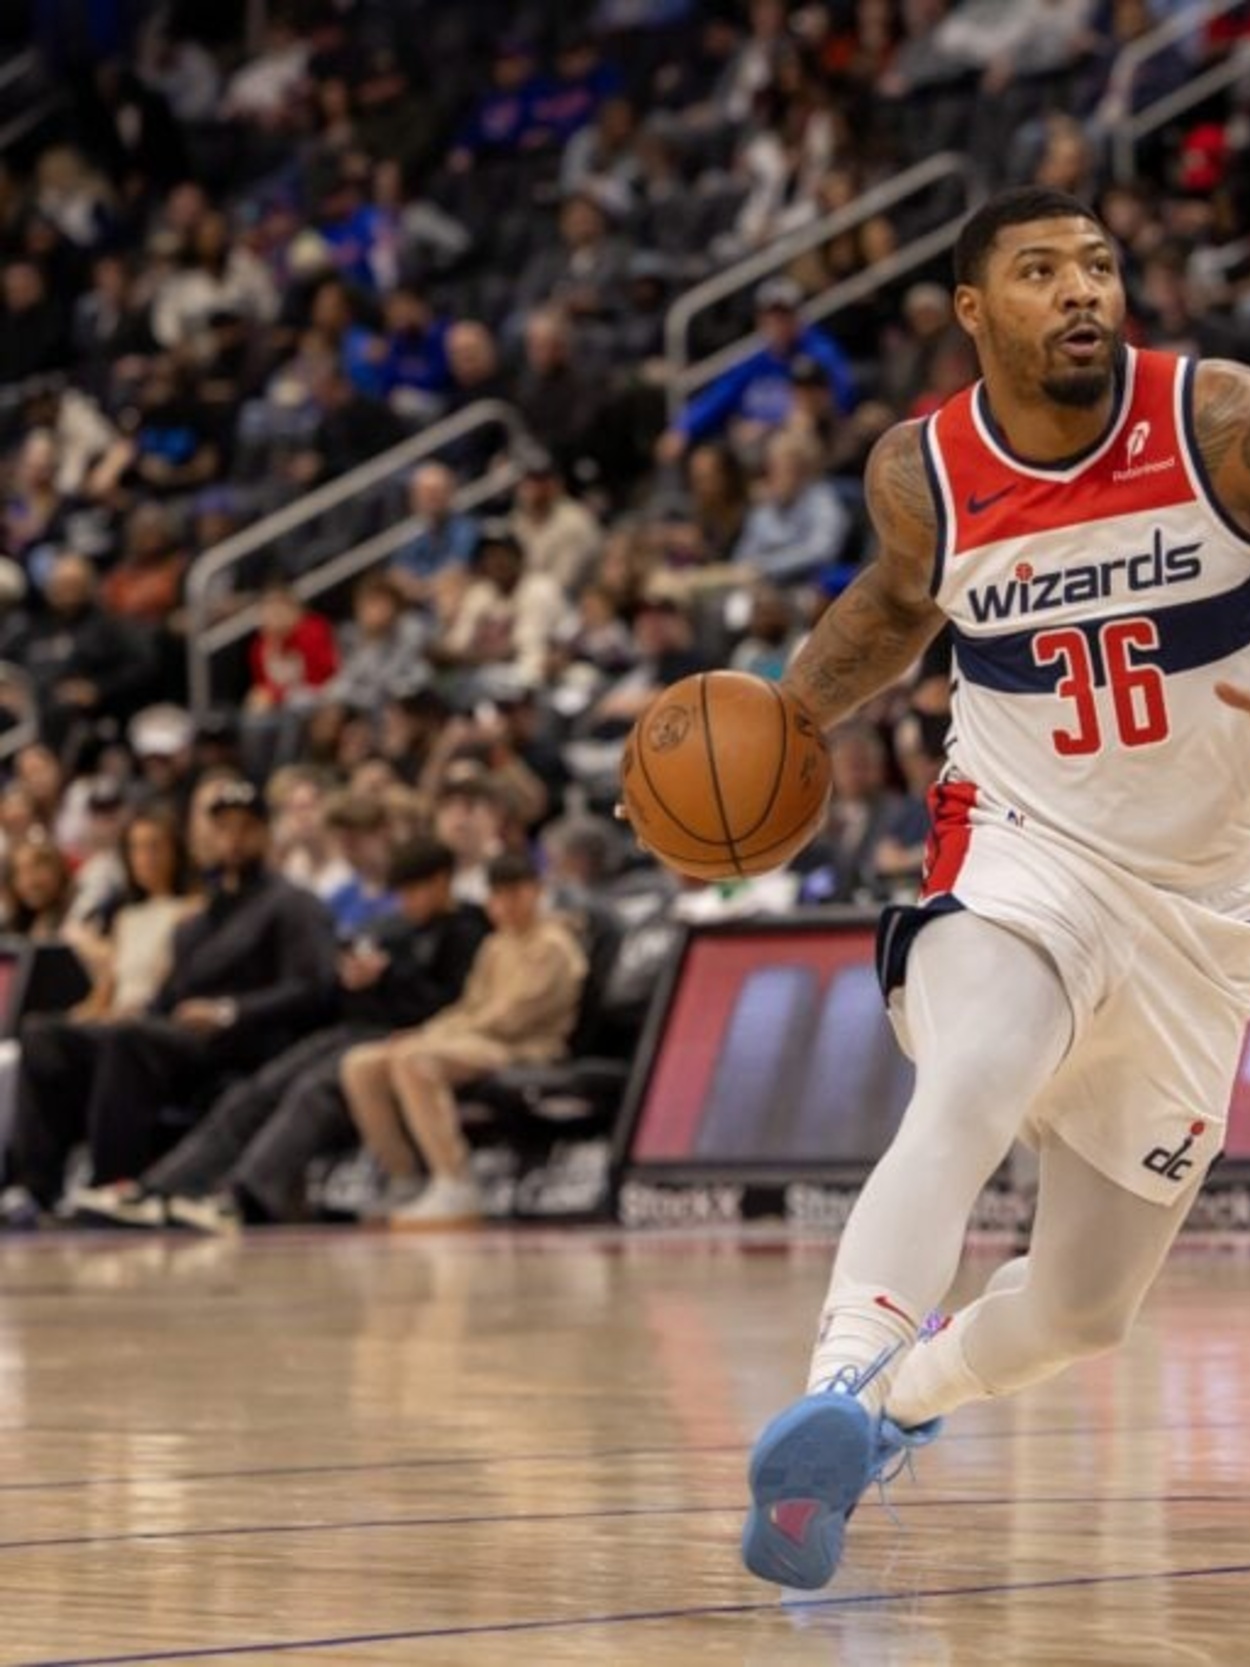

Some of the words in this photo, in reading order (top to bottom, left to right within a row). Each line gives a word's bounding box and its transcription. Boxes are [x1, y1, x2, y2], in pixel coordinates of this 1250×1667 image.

[968, 528, 1204, 623] wizards
[1032, 617, 1170, 757] 36
[619, 1182, 745, 1227] StockX
